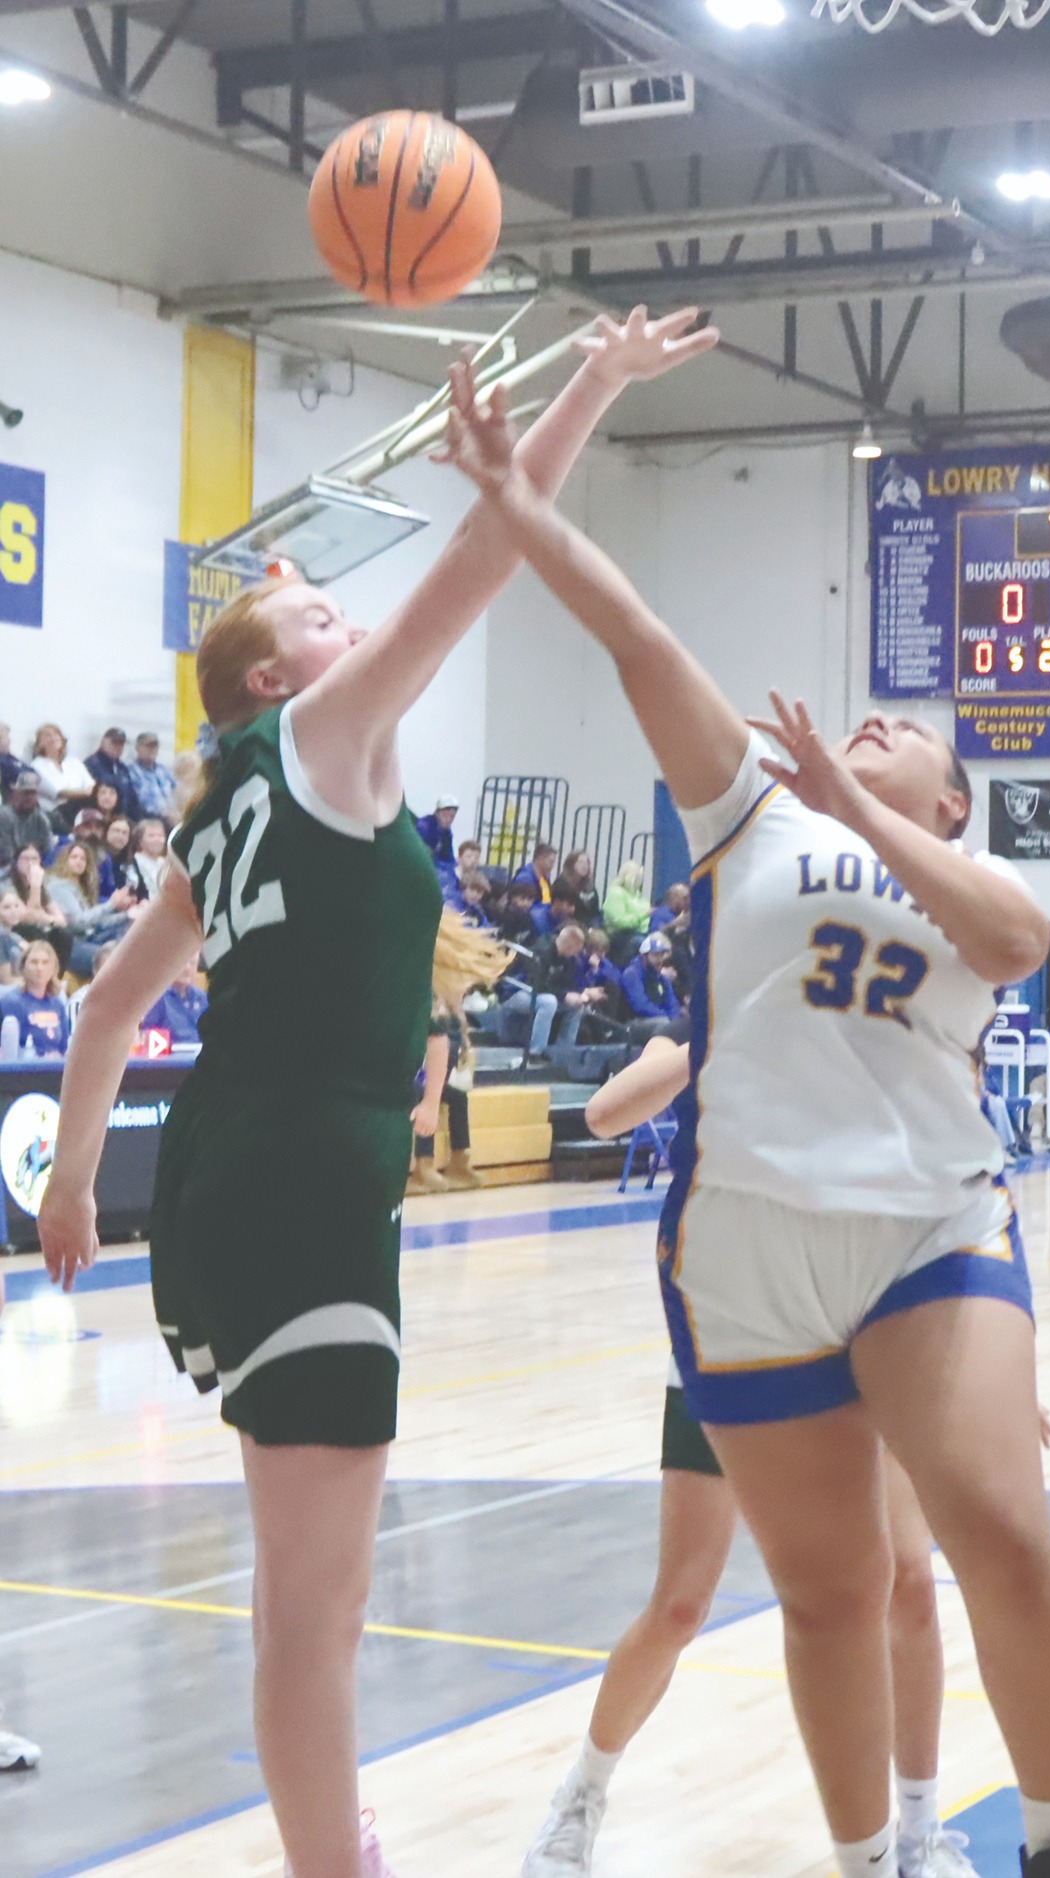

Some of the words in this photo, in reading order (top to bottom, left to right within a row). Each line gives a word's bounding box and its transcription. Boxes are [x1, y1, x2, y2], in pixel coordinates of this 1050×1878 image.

[927, 465, 1020, 497] LOWRY
[893, 518, 934, 533] PLAYER
[0, 500, 38, 586] S
[965, 560, 1050, 582] BUCKAROOS
[1002, 583, 1024, 625] 0
[962, 627, 998, 642] FOULS
[975, 641, 993, 674] 0
[961, 677, 998, 693] SCORE
[974, 720, 1046, 737] Century
[990, 736, 1032, 752] Club
[187, 772, 288, 971] 22
[797, 852, 922, 914] LOW
[803, 918, 932, 1030] 32
